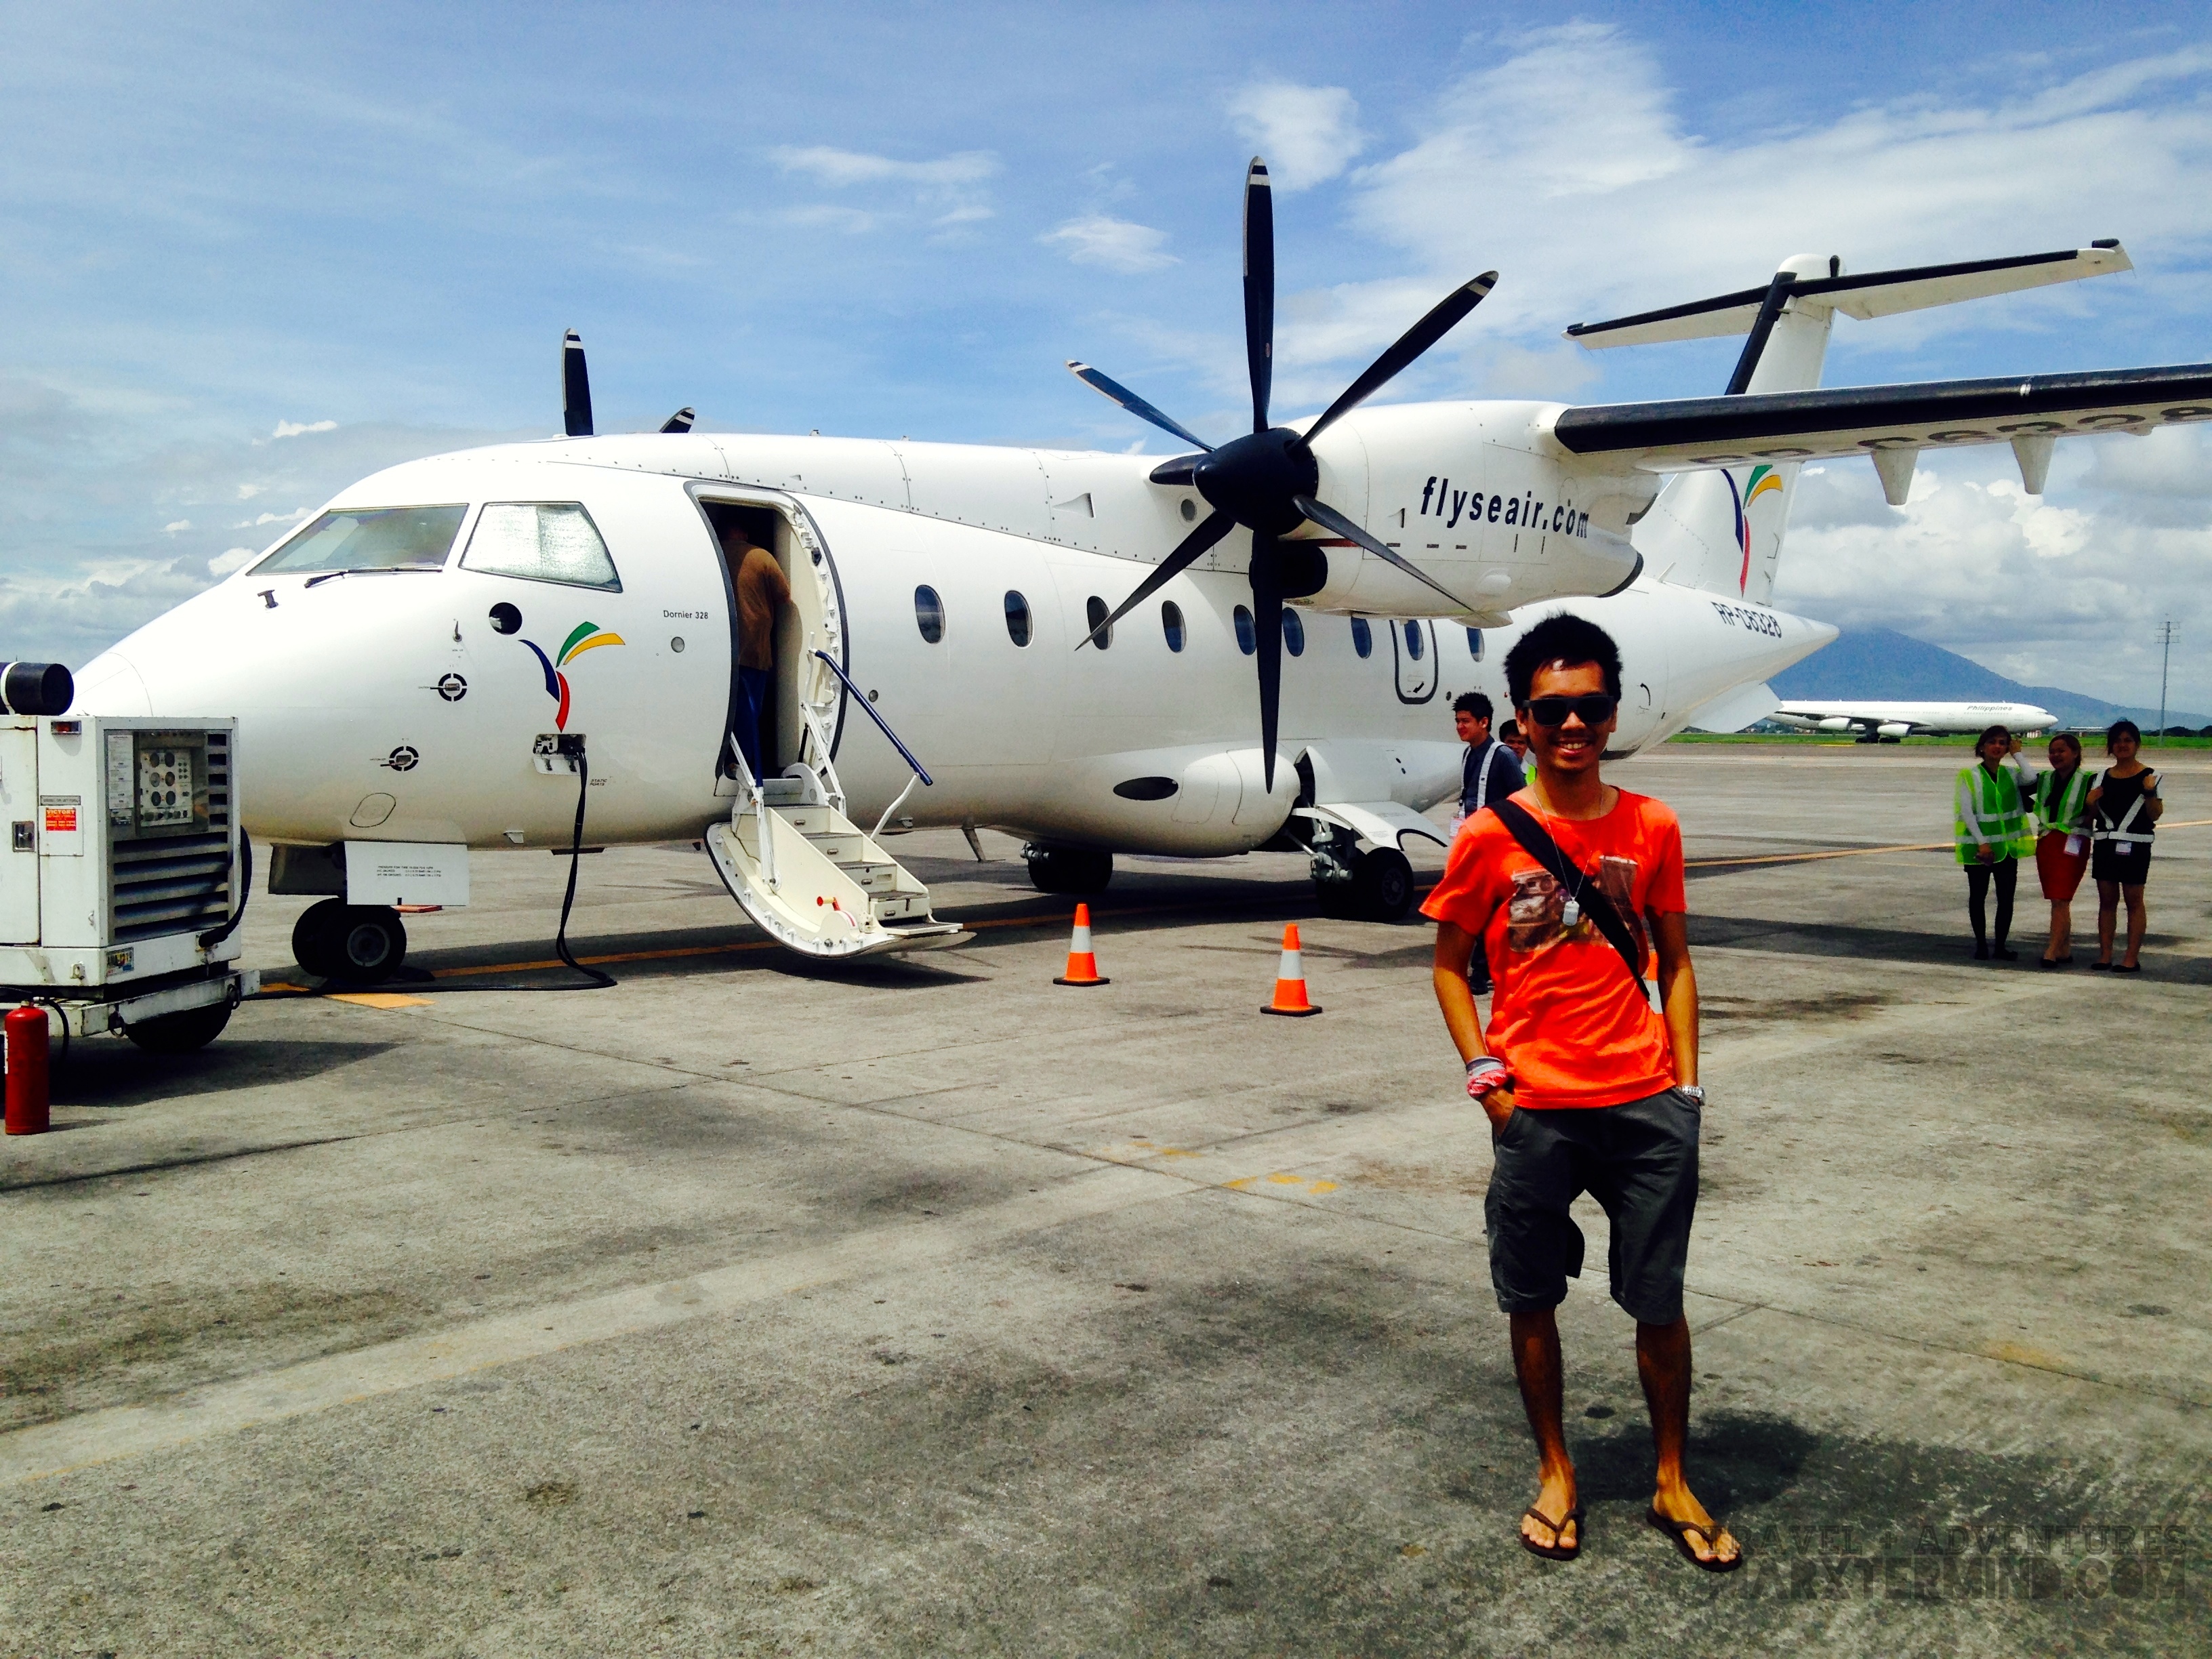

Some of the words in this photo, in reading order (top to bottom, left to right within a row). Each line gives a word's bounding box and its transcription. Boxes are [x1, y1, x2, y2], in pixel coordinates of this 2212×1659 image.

[1420, 476, 1589, 539] flyseair.com
[663, 610, 693, 618] Dornier
[695, 611, 709, 619] 328
[1711, 601, 1782, 638] RP-C6328
